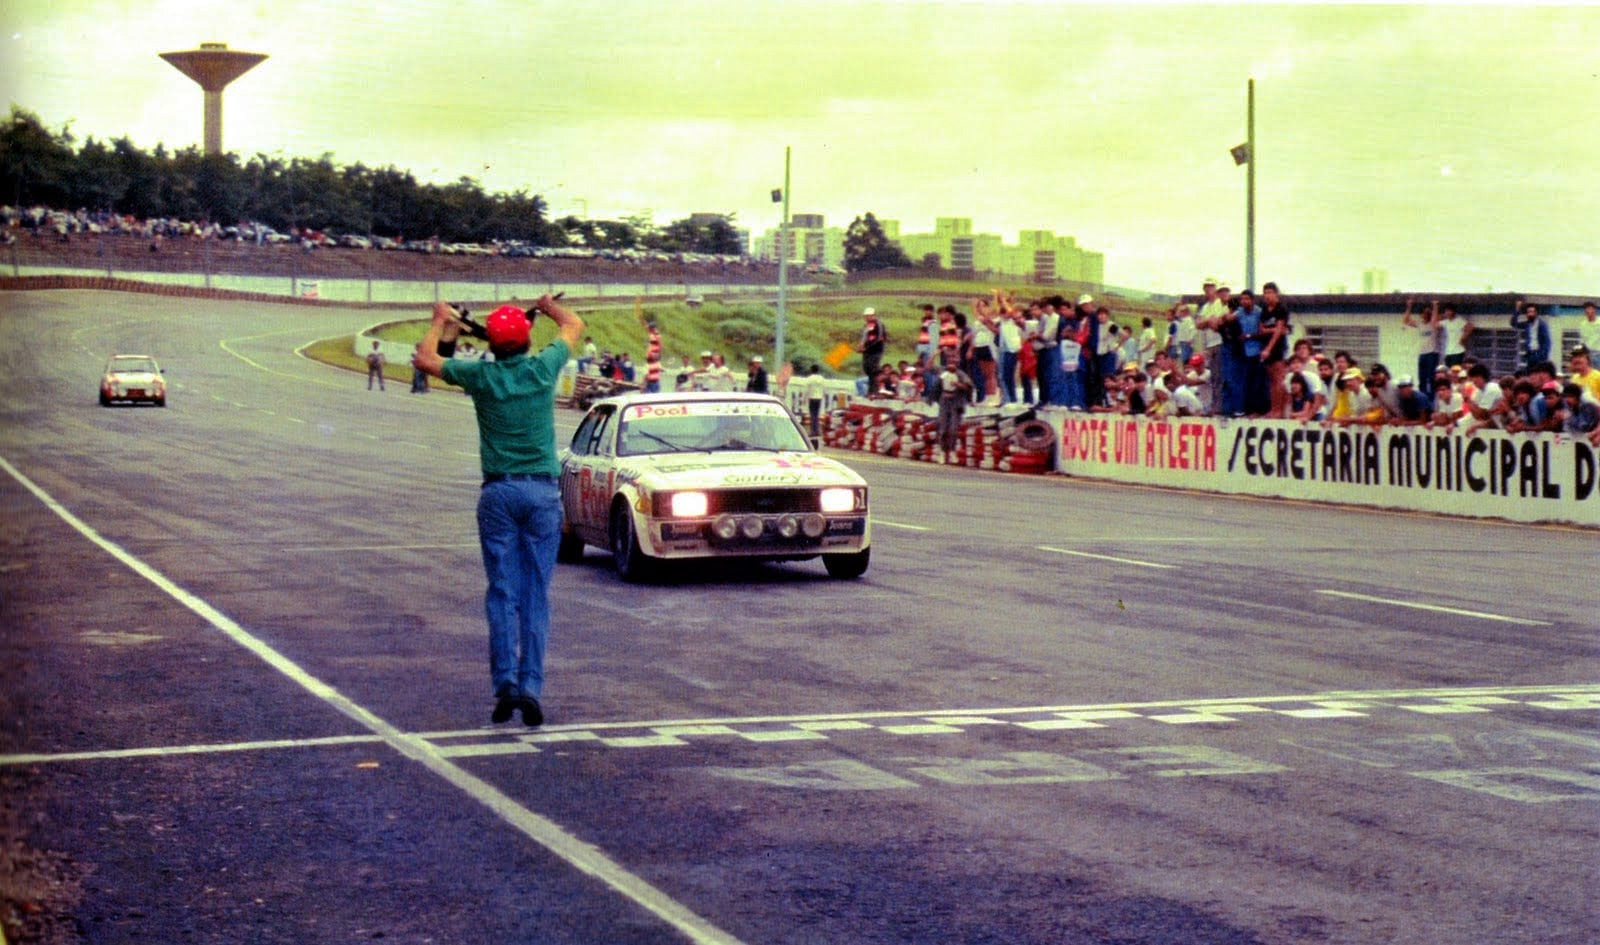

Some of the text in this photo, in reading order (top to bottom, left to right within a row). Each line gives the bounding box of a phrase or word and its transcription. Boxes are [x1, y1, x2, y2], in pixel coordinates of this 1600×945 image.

[635, 405, 688, 418] Pool
[1146, 422, 1216, 472] ATLETA
[1388, 433, 1560, 499] MUNICIPAL
[1574, 441, 1600, 501] D
